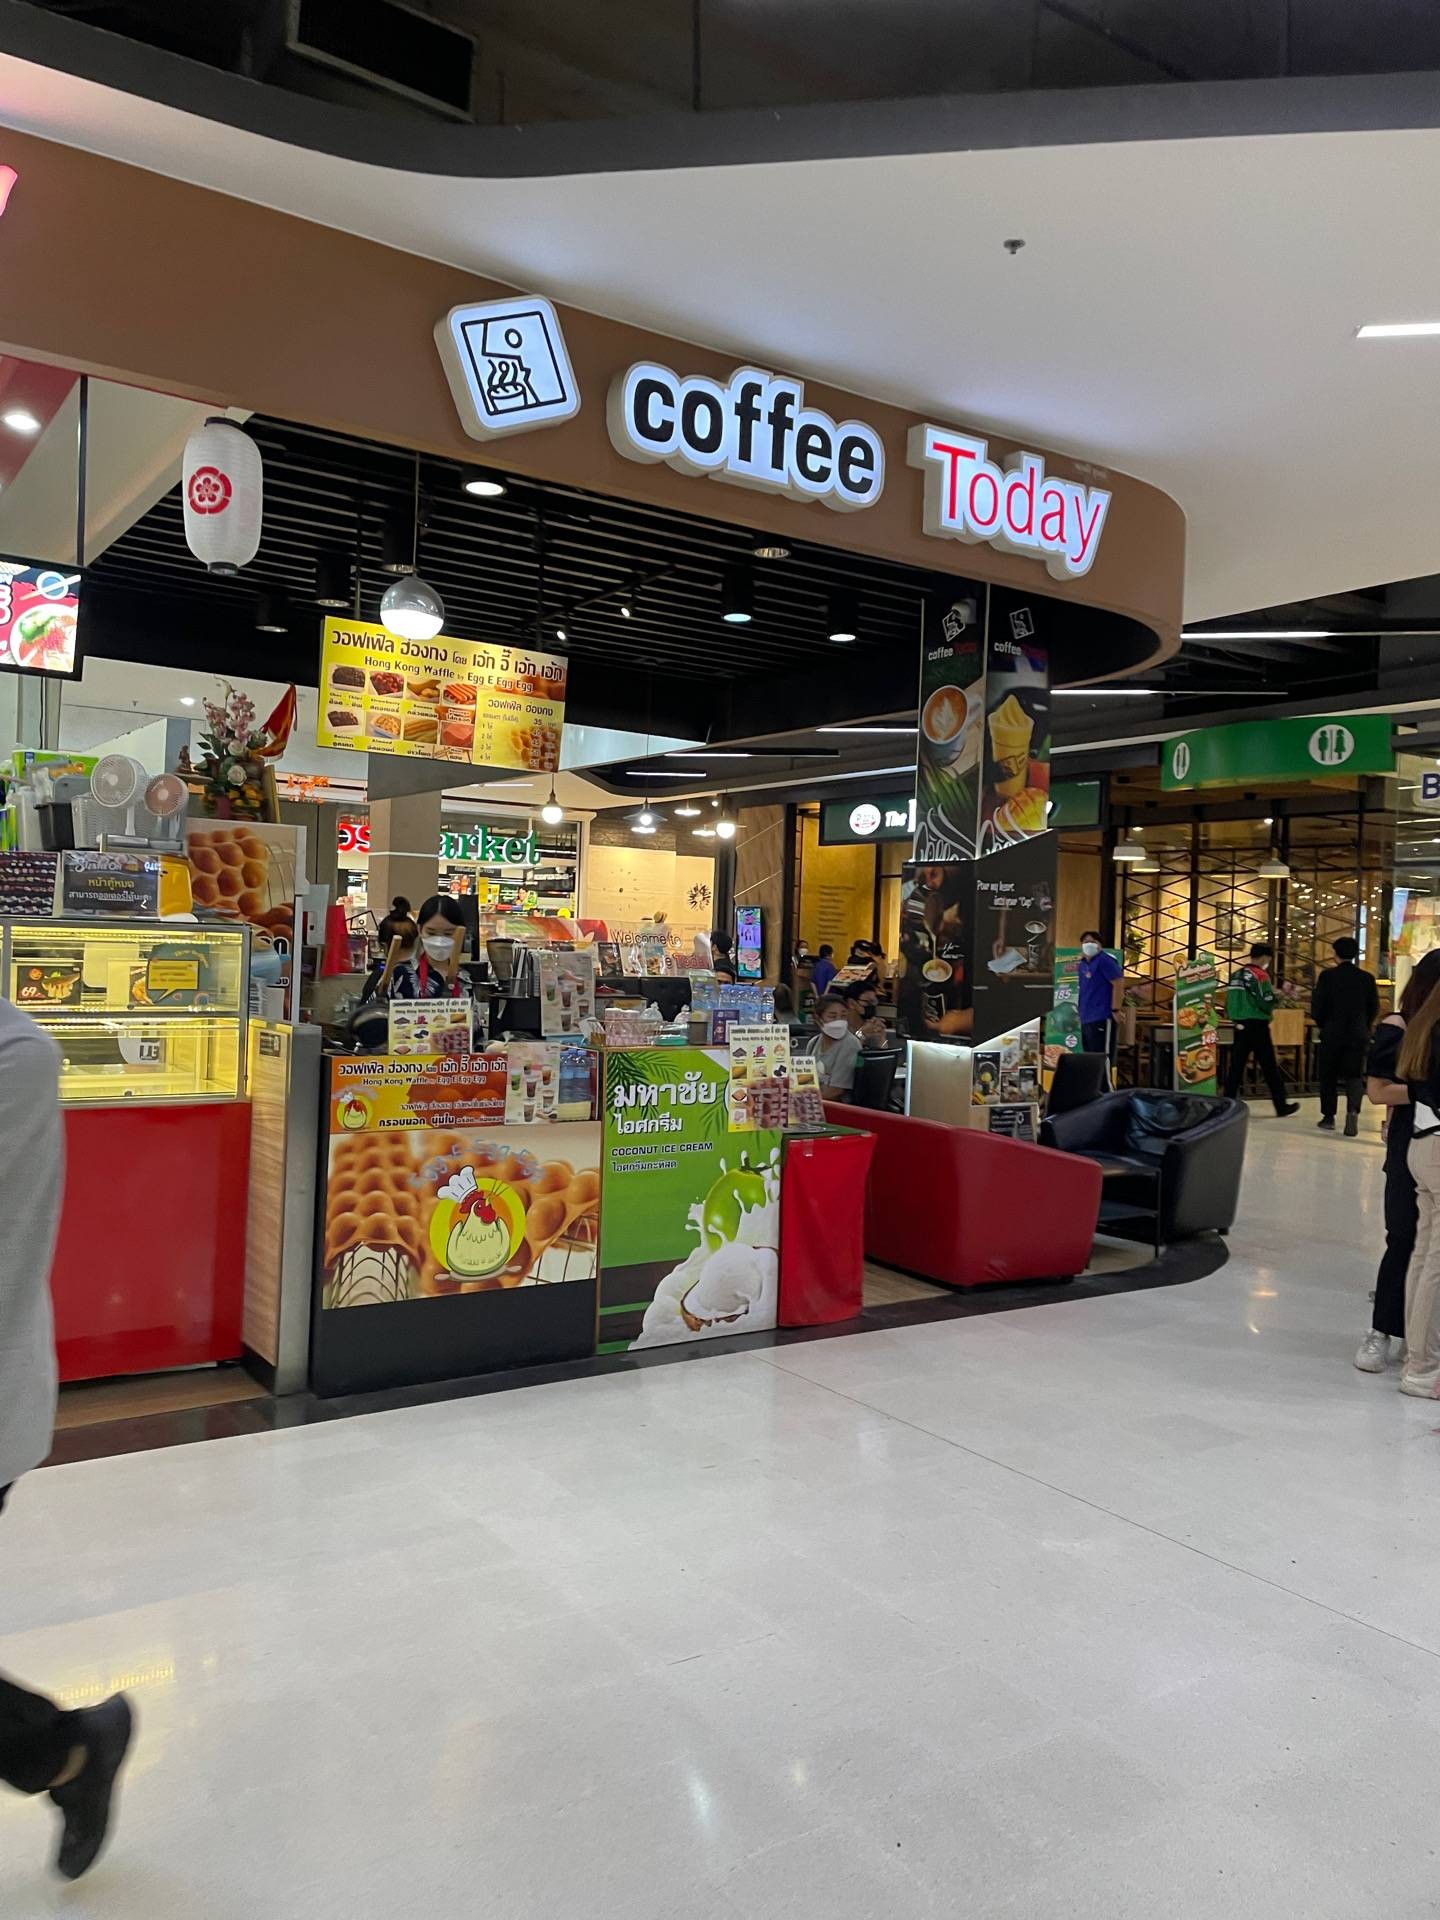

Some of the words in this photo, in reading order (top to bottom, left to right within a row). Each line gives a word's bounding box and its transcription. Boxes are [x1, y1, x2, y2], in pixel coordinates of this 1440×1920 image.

[631, 378, 875, 494] coffee
[931, 441, 1102, 563] Today
[332, 630, 395, 653] วอฟเฟิล
[400, 639, 448, 661] ฮ่องกง
[928, 646, 954, 660] coffee
[994, 642, 1022, 656] coffee
[365, 656, 391, 670] Hong
[394, 661, 420, 675] Kong
[424, 665, 455, 679] Waffle
[467, 672, 485, 685] Egg
[487, 675, 494, 684] E
[496, 677, 513, 689] Egg
[516, 679, 533, 693] Egg
[438, 824, 541, 865] arket
[610, 929, 667, 945] Welcome
[669, 933, 681, 945] to
[339, 1061, 384, 1075] วอฟเฟิล
[388, 1060, 423, 1074] ฮ่องกง
[613, 1071, 717, 1108] มหาชัย
[379, 1117, 426, 1127] กรอบนอก
[613, 1111, 683, 1135] ไอศกรีม
[611, 1145, 659, 1157] COCONUT
[661, 1144, 676, 1153] ICE
[679, 1142, 713, 1152] CREAM
[612, 1159, 677, 1173] ไอศกรีมกะทิสด
